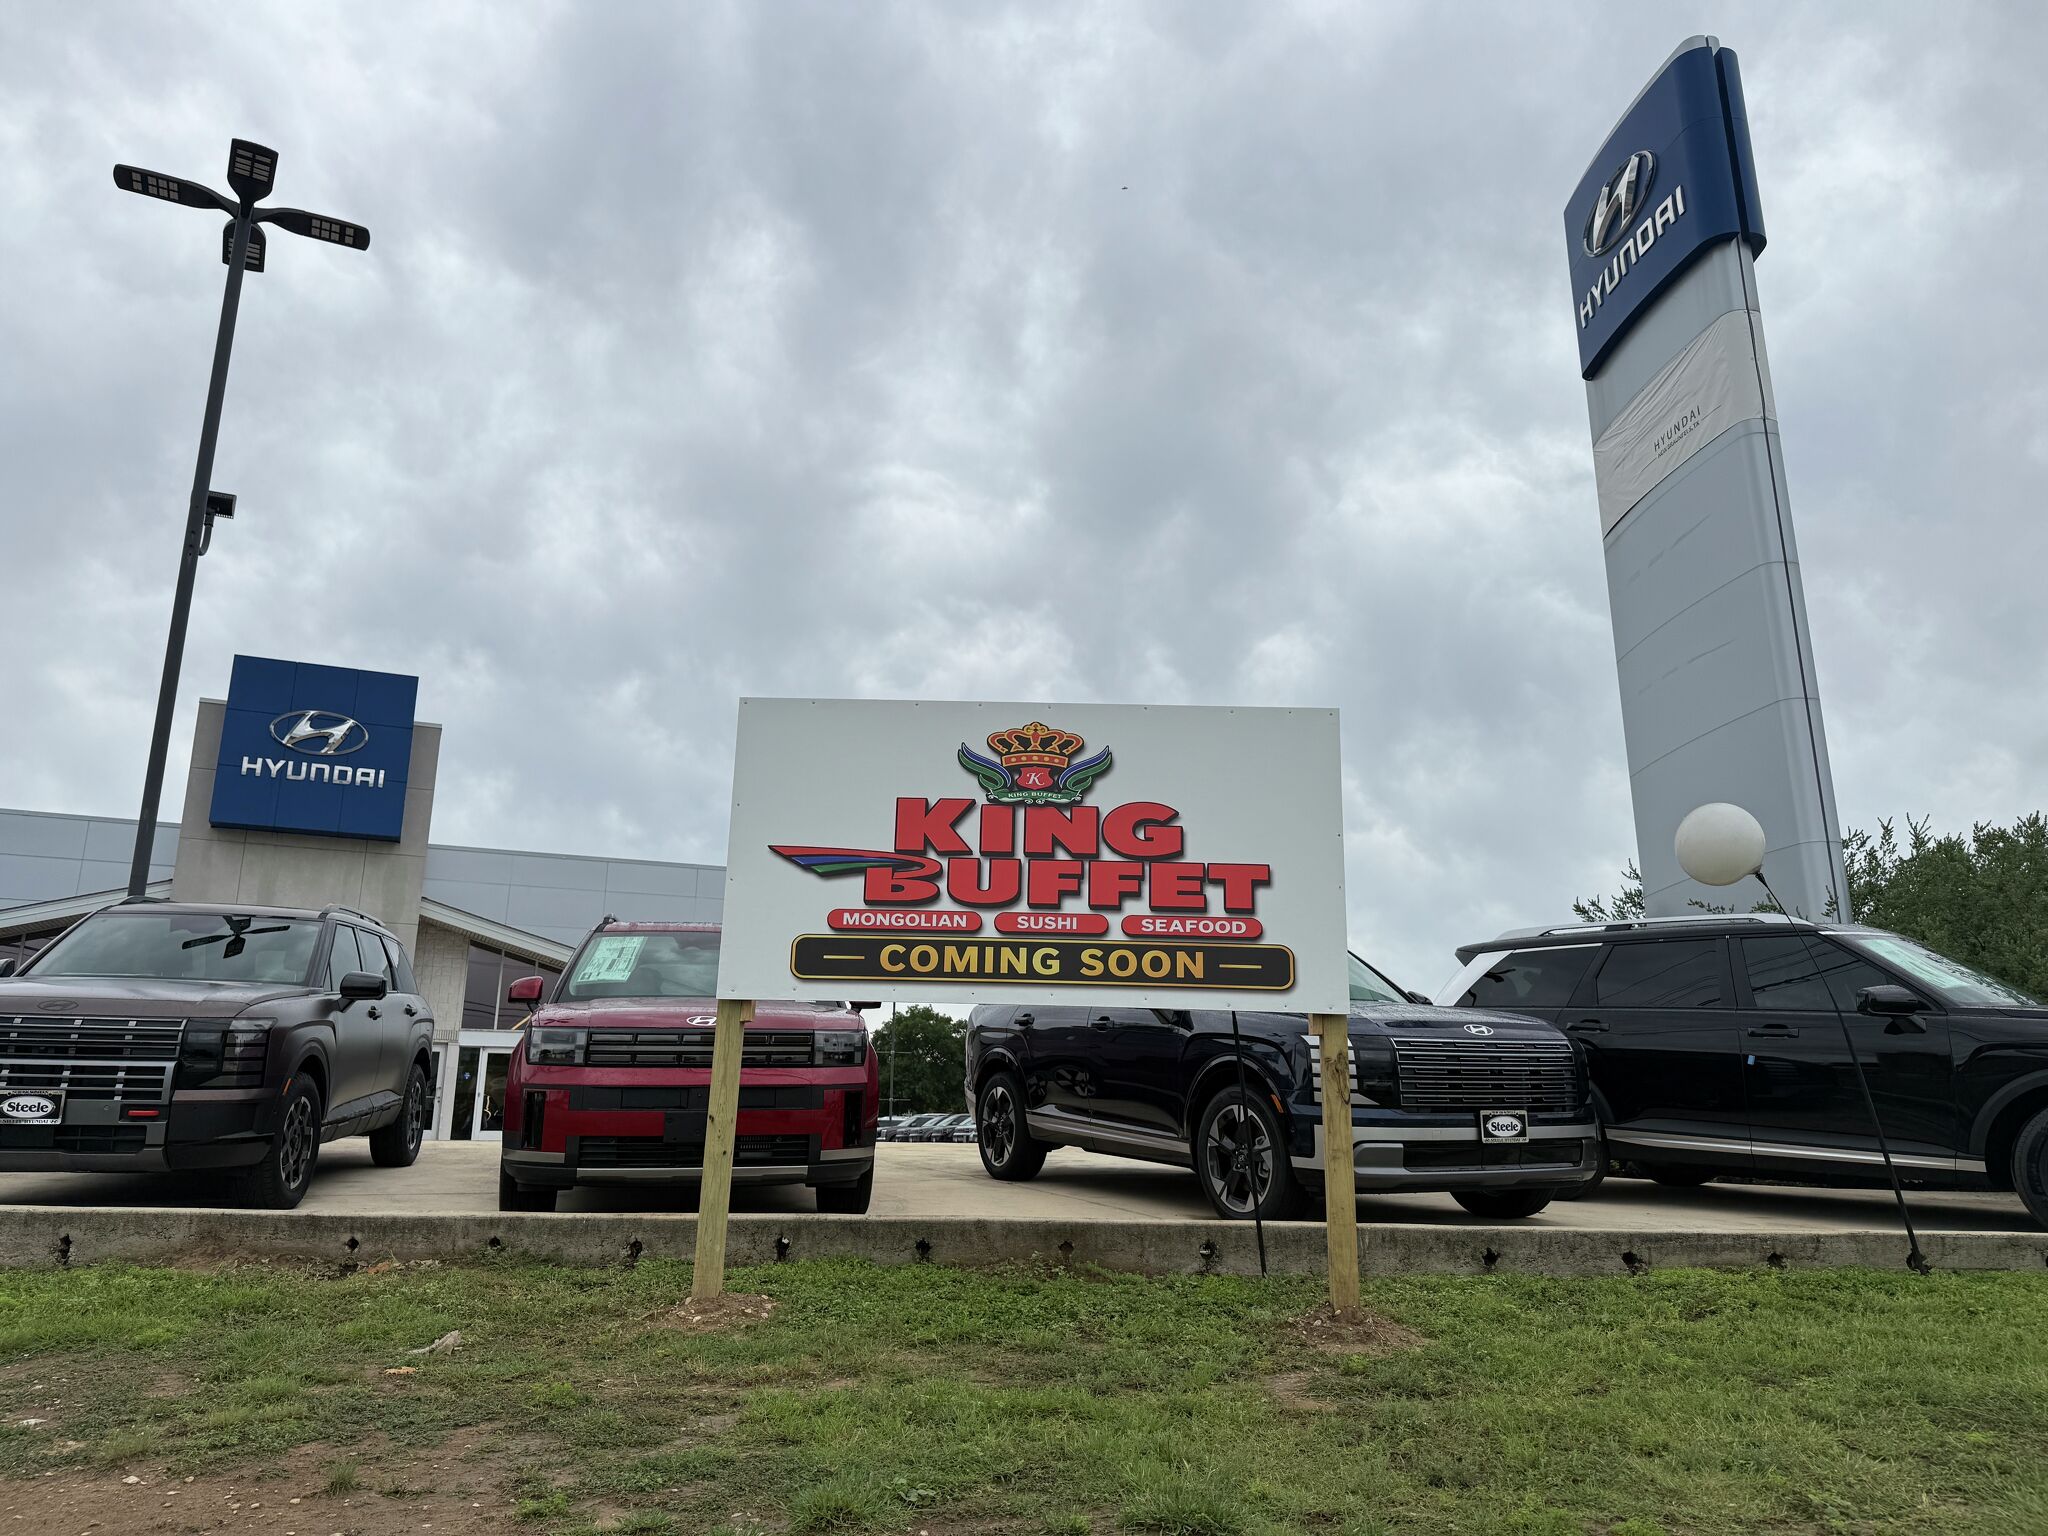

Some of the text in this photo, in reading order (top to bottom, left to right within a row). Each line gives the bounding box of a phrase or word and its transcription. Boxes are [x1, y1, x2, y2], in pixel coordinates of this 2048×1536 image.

[1578, 184, 1687, 330] HYUNDAI
[1653, 405, 1701, 453] HYUNDAI
[240, 756, 386, 789] HYUNDAI
[1026, 772, 1046, 786] K
[894, 797, 1184, 861] KING
[864, 853, 1271, 913] BUFFET
[842, 913, 968, 929] MONGOLIAN
[1016, 915, 1078, 931] SUSHI
[1140, 918, 1247, 935] SEAFOOD
[879, 944, 1205, 980] COMING SOON
[6, 1101, 49, 1113] Steele
[1490, 1121, 1519, 1132] Steele
